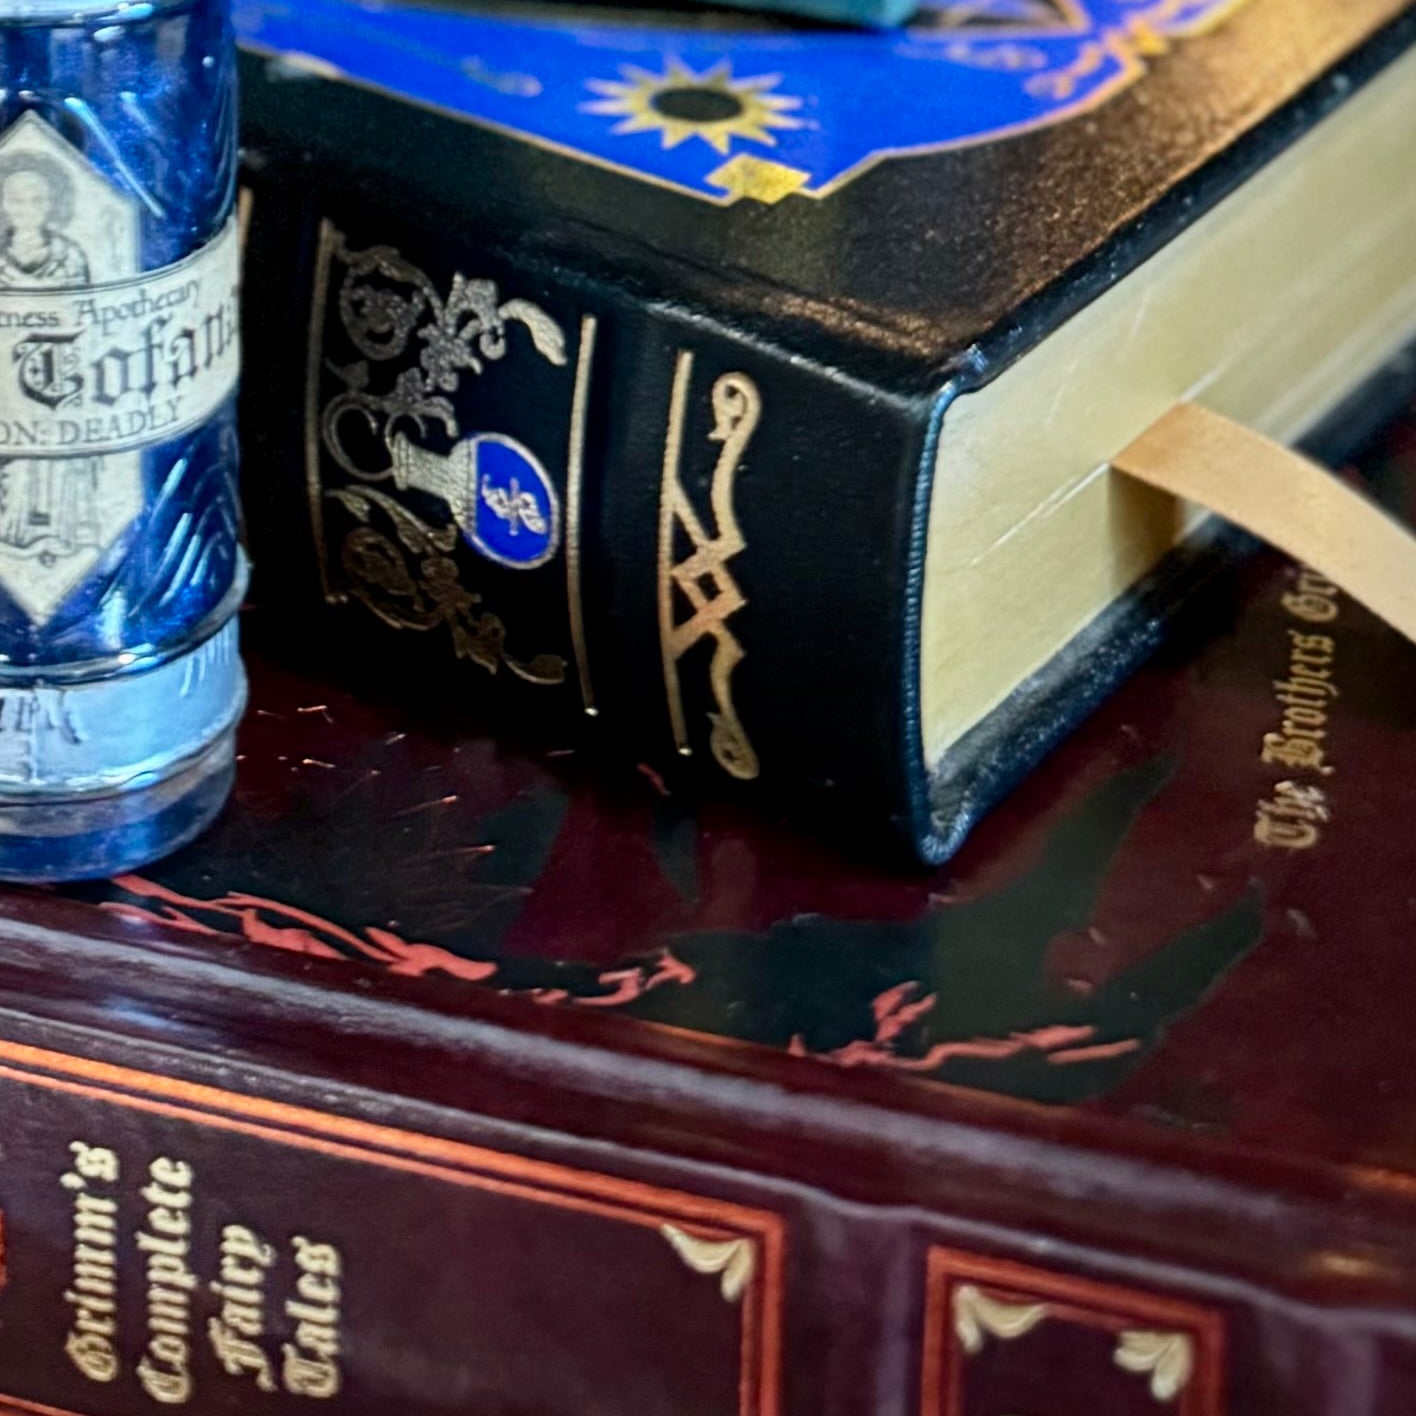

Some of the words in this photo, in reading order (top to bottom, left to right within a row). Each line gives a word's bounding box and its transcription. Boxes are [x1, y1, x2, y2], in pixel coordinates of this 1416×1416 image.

[74, 279, 201, 335] Apothecary
[57, 395, 183, 444] DEADLY
[1260, 629, 1339, 776] Brothers
[1253, 780, 1329, 849] The
[60, 1140, 120, 1382] Grimm's
[136, 1157, 199, 1403] Complete
[207, 1224, 278, 1392] Fairy
[282, 1236, 342, 1398] Tales
